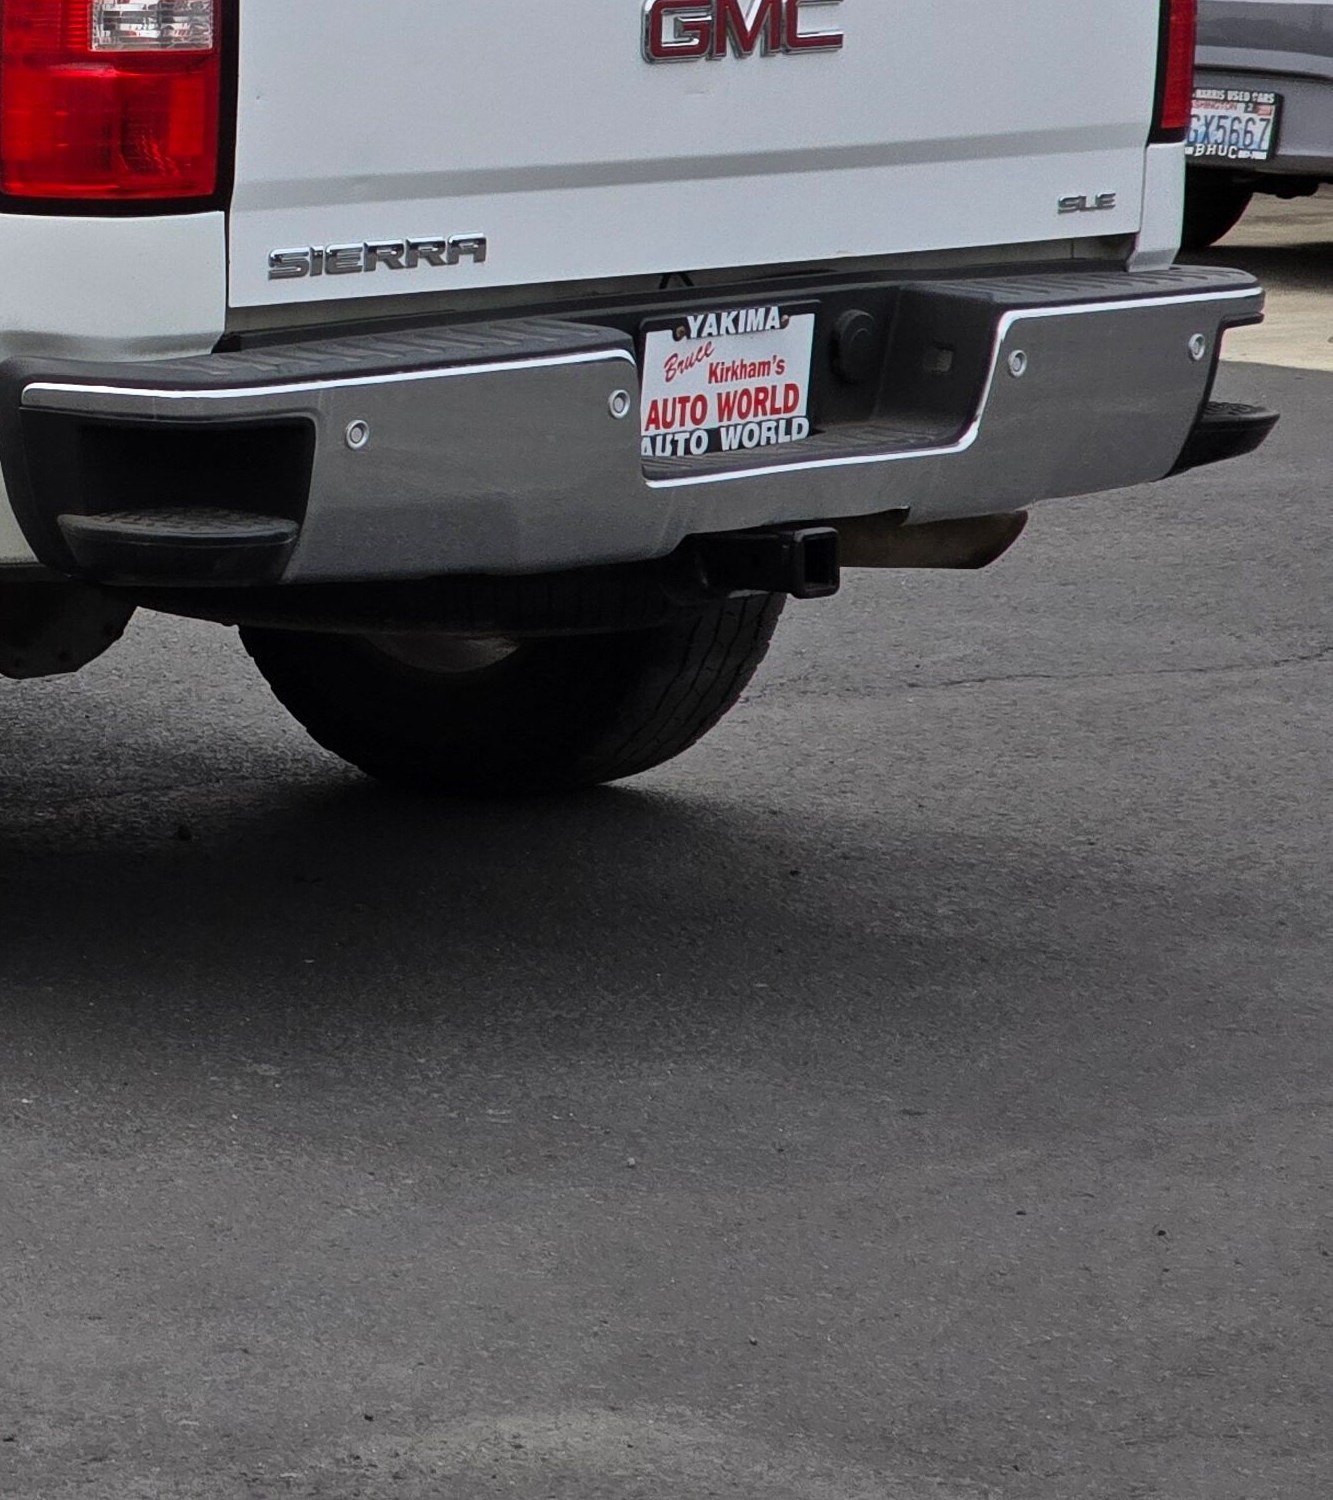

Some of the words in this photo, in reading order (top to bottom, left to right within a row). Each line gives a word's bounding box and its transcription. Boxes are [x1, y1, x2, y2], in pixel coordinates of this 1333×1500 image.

[1227, 90, 1251, 102] USED
[1252, 91, 1275, 104] CARS
[1194, 143, 1238, 159] BHUC
[1057, 192, 1117, 215] SLE
[268, 232, 488, 281] SIERRA
[687, 306, 781, 339] YAKIMA
[664, 341, 715, 383] Bruce
[708, 355, 786, 384] Kirkham's
[645, 394, 709, 432] AUTO
[717, 383, 801, 422] WORLD
[641, 430, 710, 457] AUTO
[720, 417, 811, 451] WORLD
